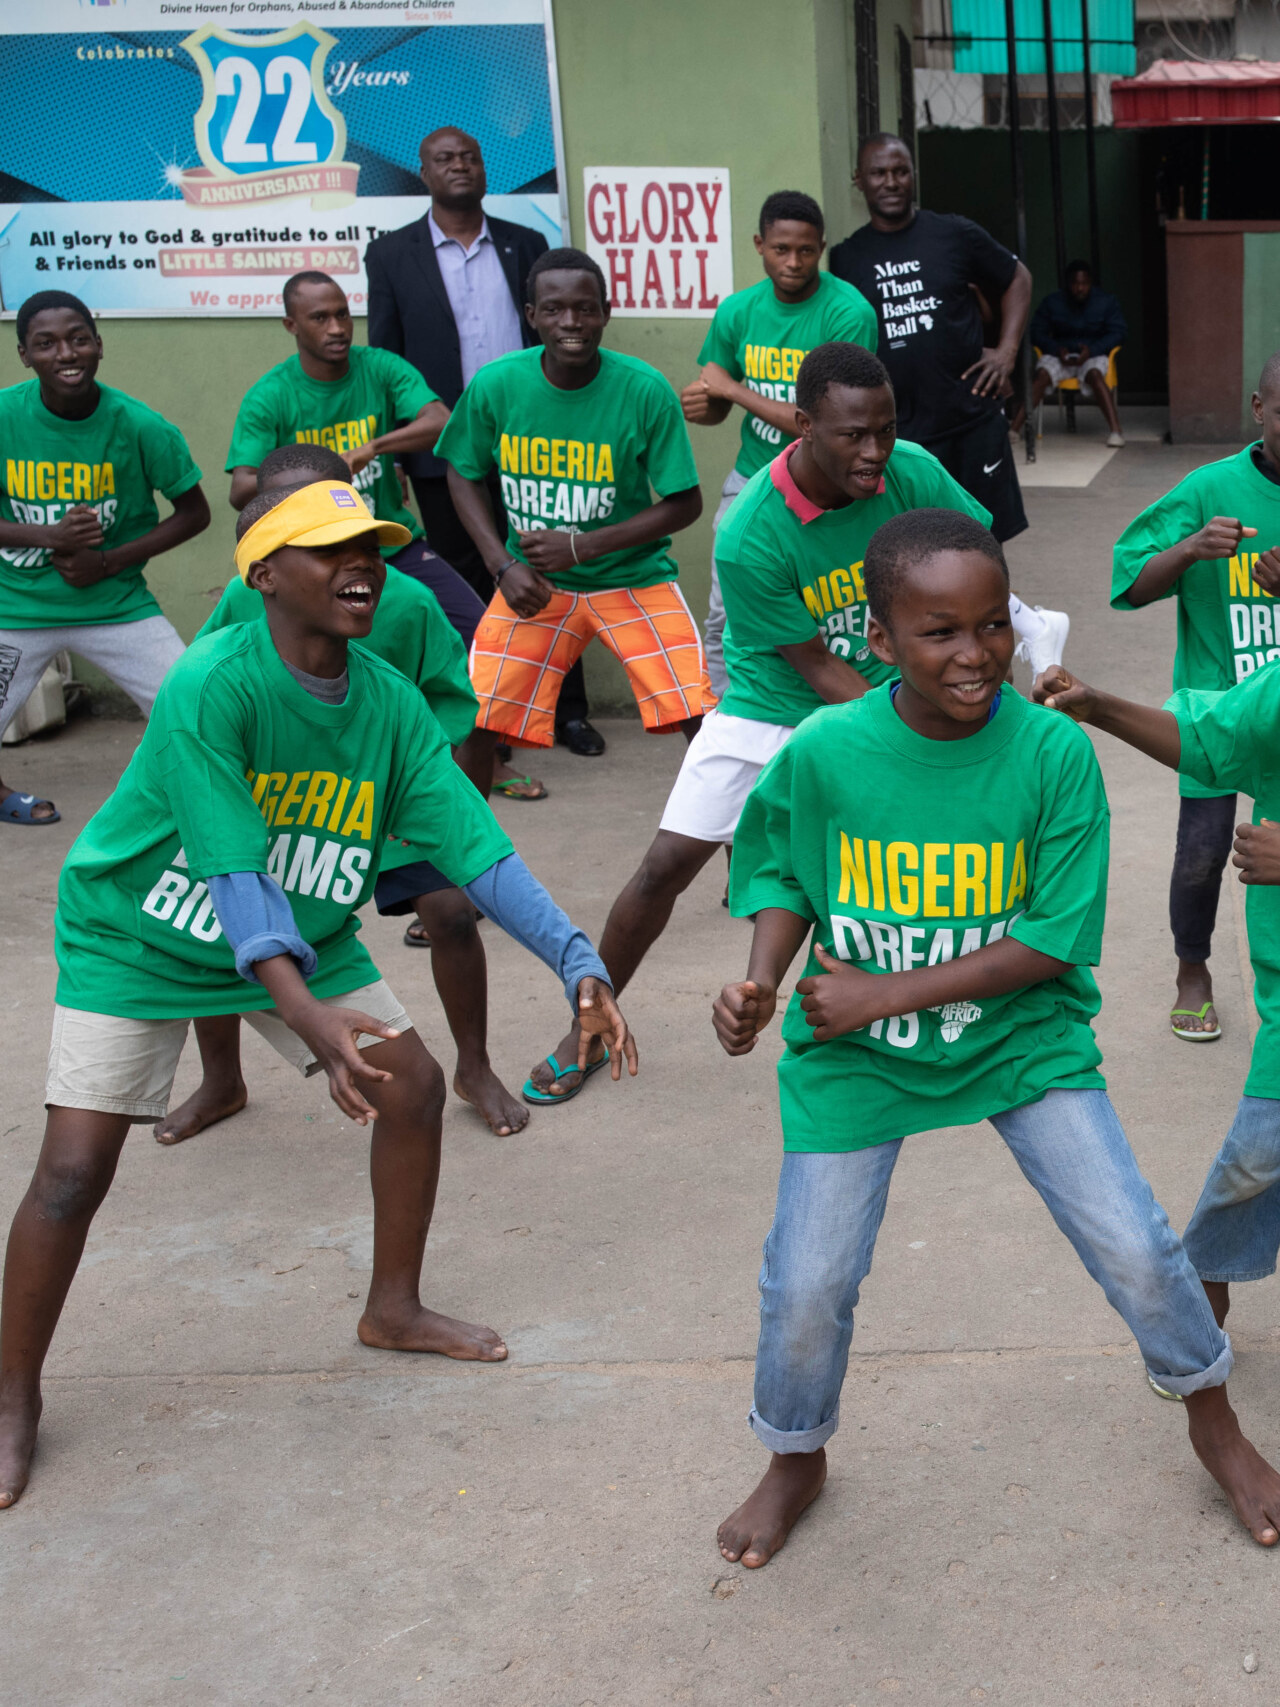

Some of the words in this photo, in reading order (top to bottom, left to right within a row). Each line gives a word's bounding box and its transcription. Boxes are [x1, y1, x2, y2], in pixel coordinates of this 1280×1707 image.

[160, 4, 192, 13] Divine
[195, 4, 227, 13] Haven
[230, 3, 245, 14] for
[249, 2, 294, 13] Orphans,
[298, 1, 336, 11] Abused
[338, 1, 347, 10] &
[350, 0, 410, 10] Abandoned
[412, 0, 455, 9] Children
[405, 11, 429, 20] Since
[77, 45, 174, 60] Celebrates
[326, 61, 410, 96] Years
[215, 56, 318, 163] 22
[200, 174, 320, 203] ANNIVERSARY
[588, 182, 722, 245] GLORY
[30, 231, 56, 246] All
[63, 230, 112, 250] glory
[119, 231, 138, 245] to
[145, 229, 183, 245] God
[190, 229, 205, 244] &
[212, 227, 302, 247] gratitude
[309, 228, 328, 242] to
[335, 226, 360, 241] all
[35, 256, 51, 271] &
[56, 255, 127, 271] Friends
[133, 258, 156, 270] on
[163, 253, 226, 270] LITTLE
[232, 252, 305, 270] SAINTS
[310, 251, 356, 270] DAY,
[874, 260, 921, 280] More
[606, 249, 719, 309] HALL
[877, 279, 924, 299] Than
[190, 290, 220, 306] We
[882, 296, 943, 319] Basket-
[885, 316, 918, 339] Ball
[745, 344, 811, 382] NIGER
[500, 433, 615, 482] NIGERIA
[7, 459, 115, 500] NIGERIA
[501, 474, 616, 523] DREAMS
[803, 560, 868, 620] NIGE
[246, 768, 374, 841] IGERIA
[837, 830, 1027, 917] NIGERIA
[941, 1005, 983, 1022] AFRICA
